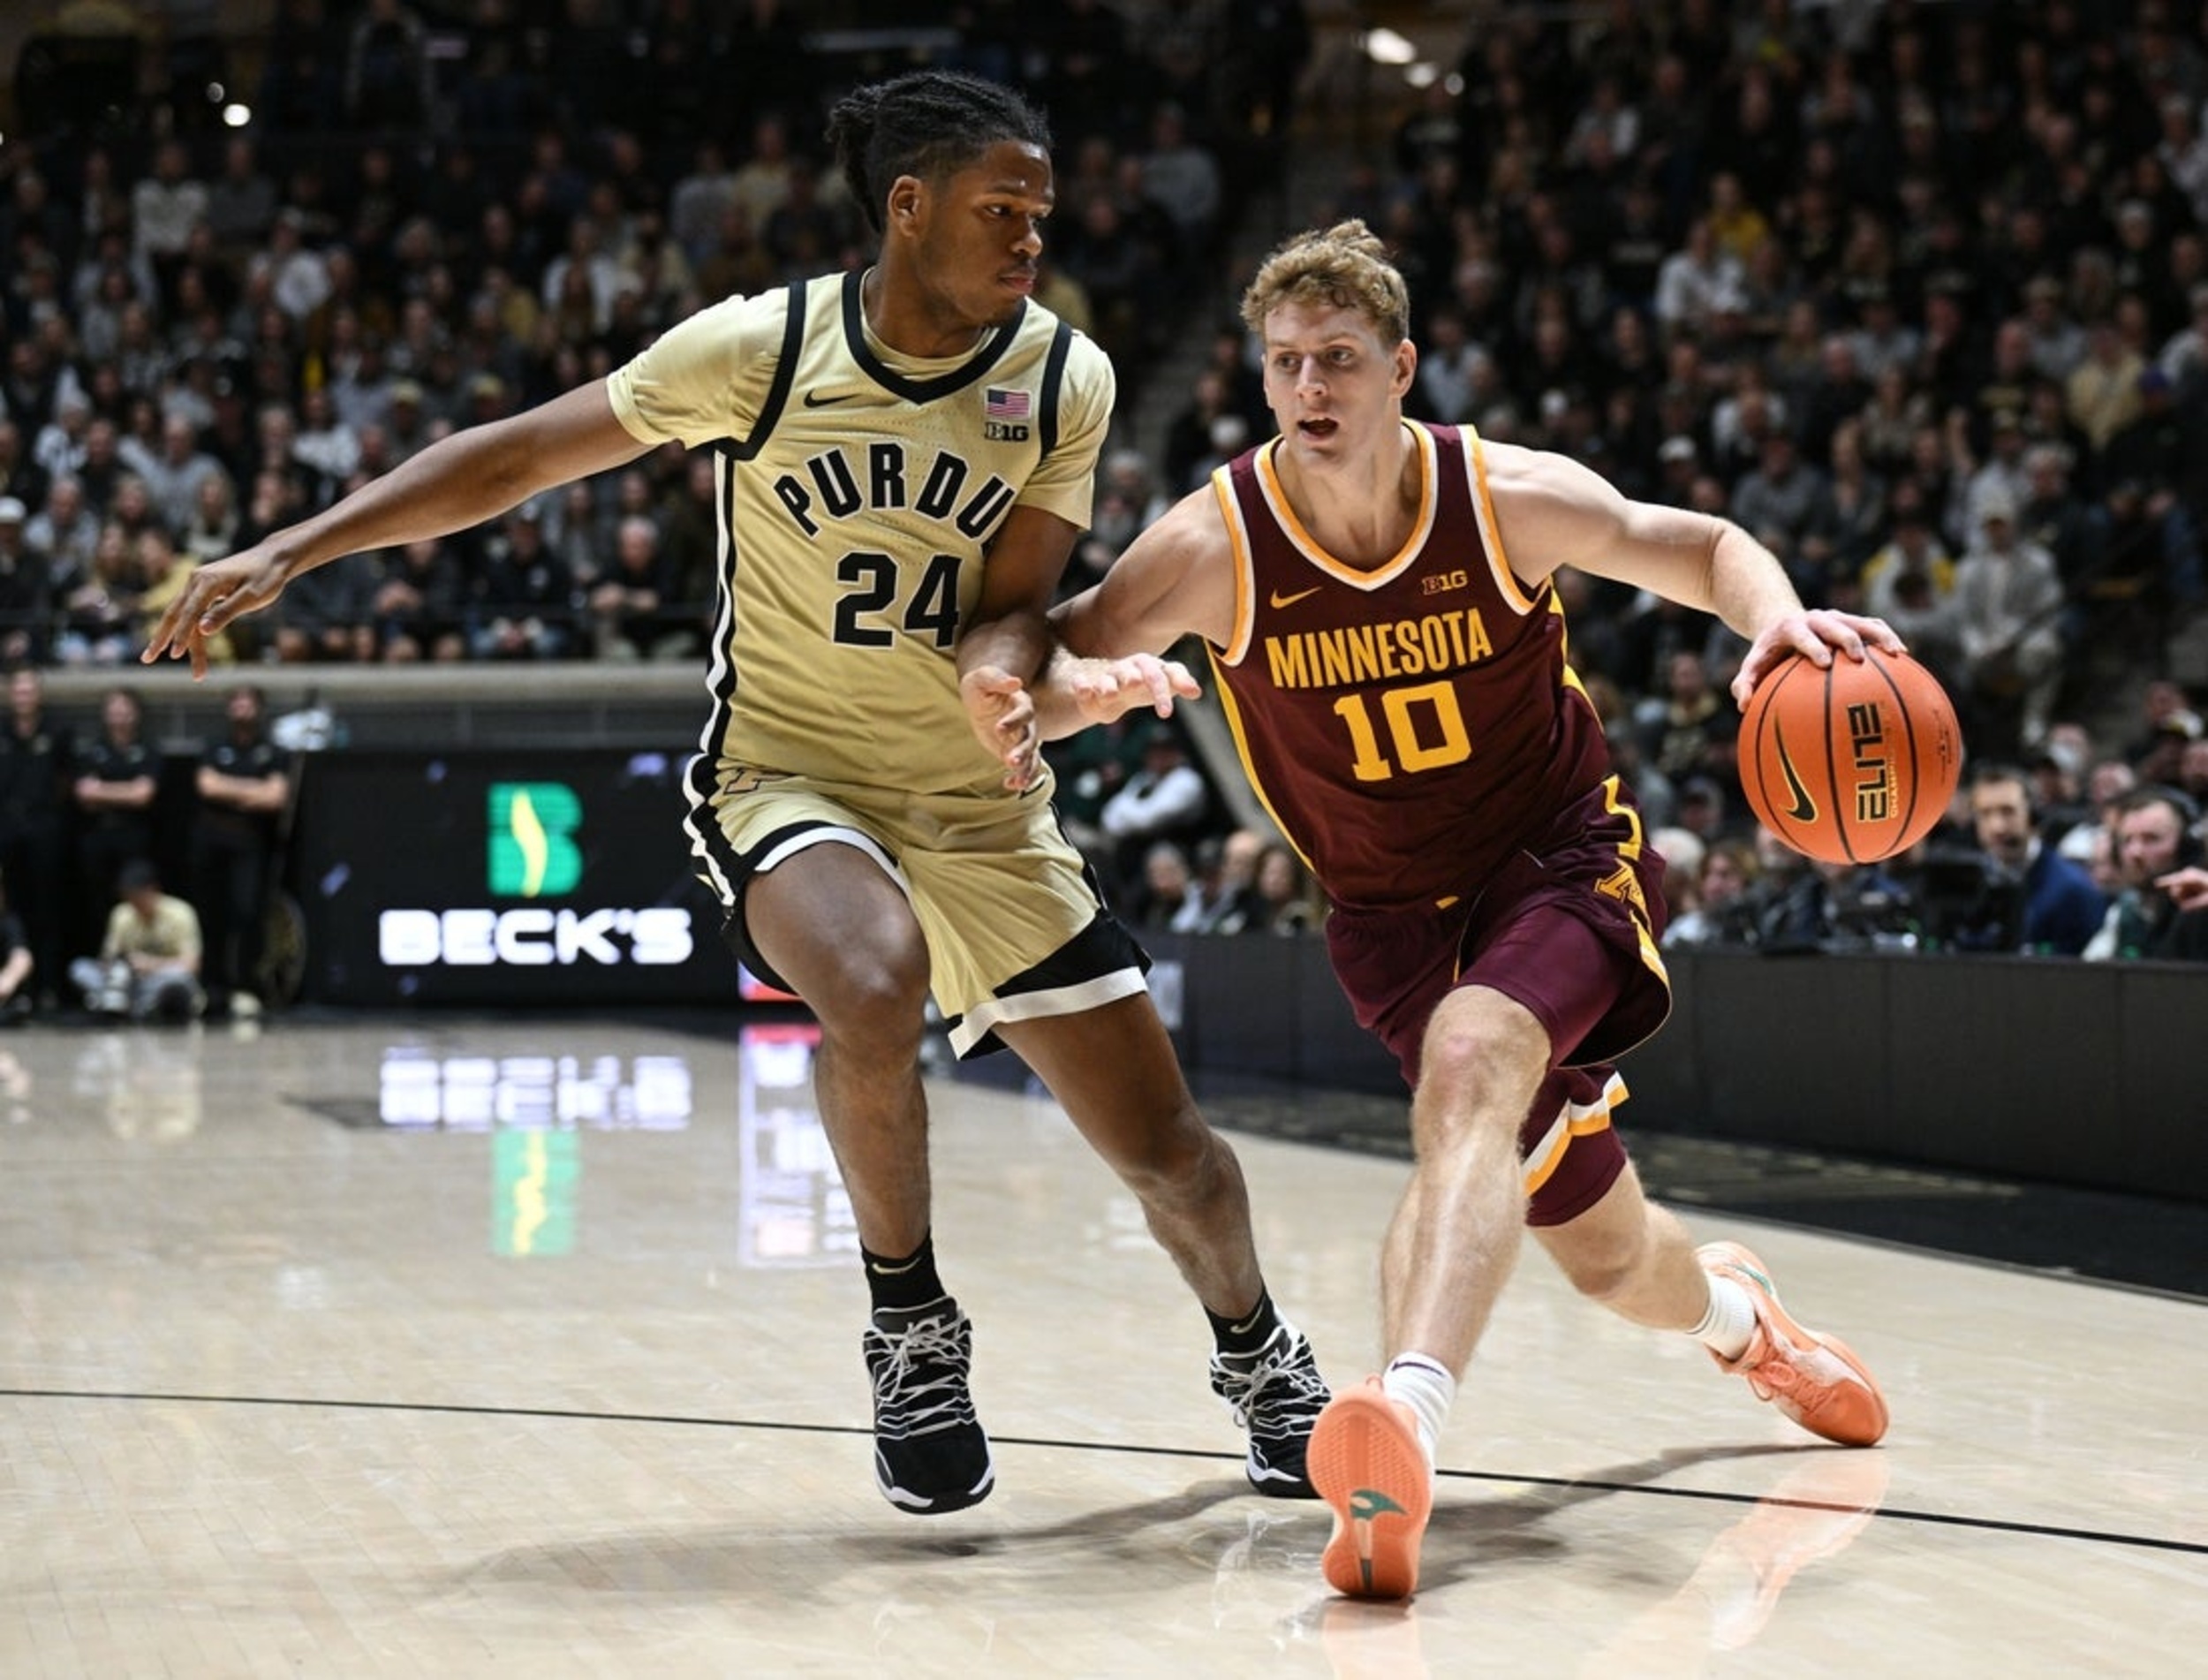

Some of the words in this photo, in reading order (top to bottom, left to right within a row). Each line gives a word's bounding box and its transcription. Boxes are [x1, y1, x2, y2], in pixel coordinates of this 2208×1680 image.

[773, 443, 1015, 549] PURDU
[833, 552, 962, 649] 24
[1266, 608, 1493, 689] MINNESOTA
[1334, 680, 1472, 781] 10
[1846, 702, 1888, 821] ELITE
[379, 908, 693, 965] BECK'S
